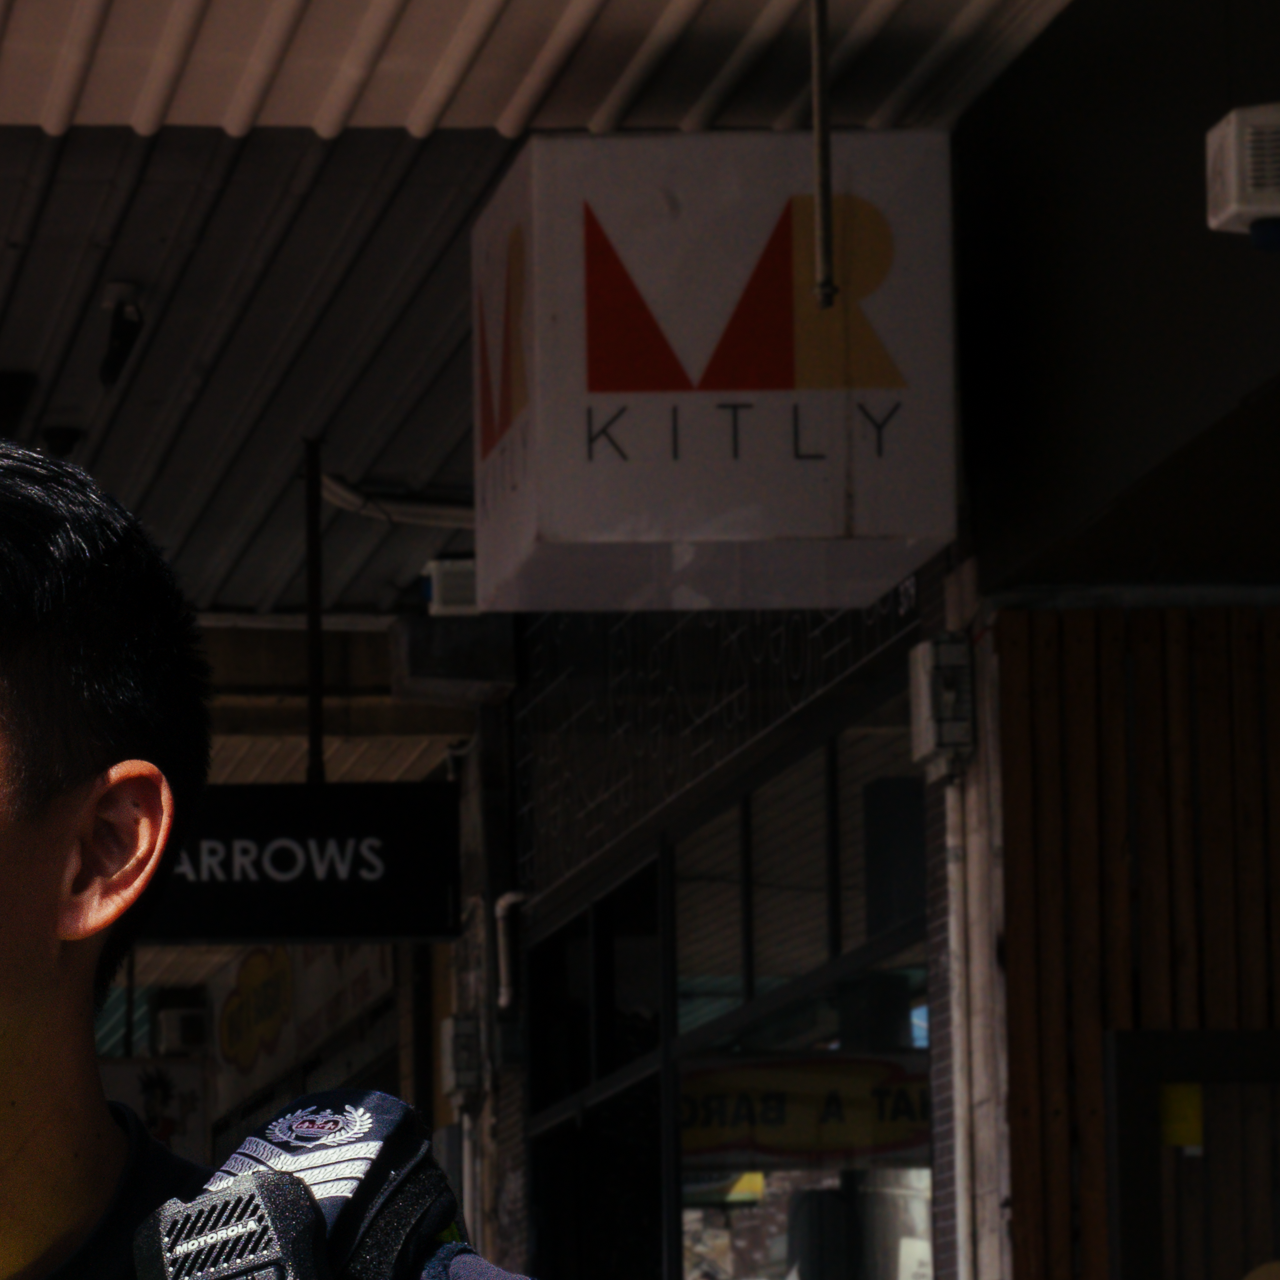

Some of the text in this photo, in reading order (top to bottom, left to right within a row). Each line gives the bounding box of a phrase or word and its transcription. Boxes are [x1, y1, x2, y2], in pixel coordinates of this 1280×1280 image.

[584, 194, 910, 393] MR
[587, 402, 902, 461] KITLY
[175, 1220, 258, 1254] MOTOROLA
